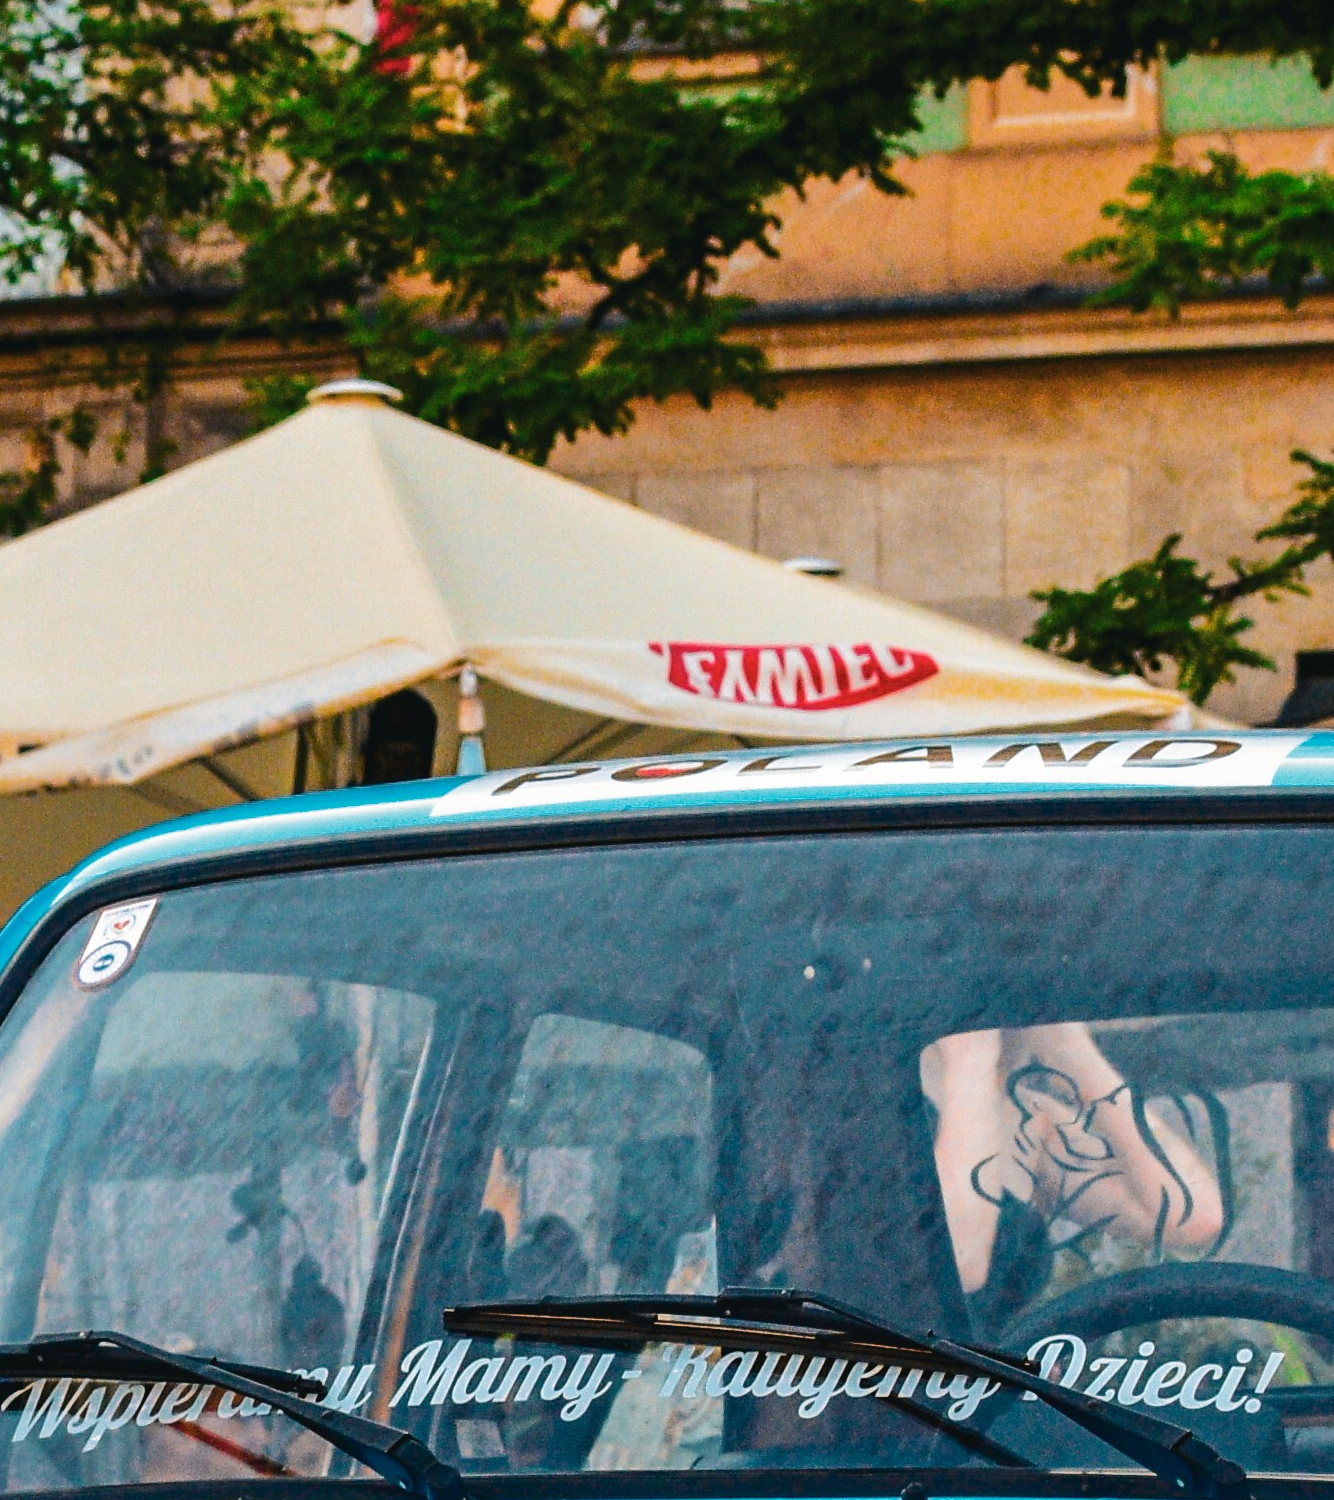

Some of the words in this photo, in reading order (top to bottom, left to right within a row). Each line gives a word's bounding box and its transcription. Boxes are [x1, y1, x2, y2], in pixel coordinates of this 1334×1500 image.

[491, 739, 1242, 796] POLAND
[388, 1339, 616, 1422] Mamy
[1013, 1334, 1286, 1414] Dzieci!
